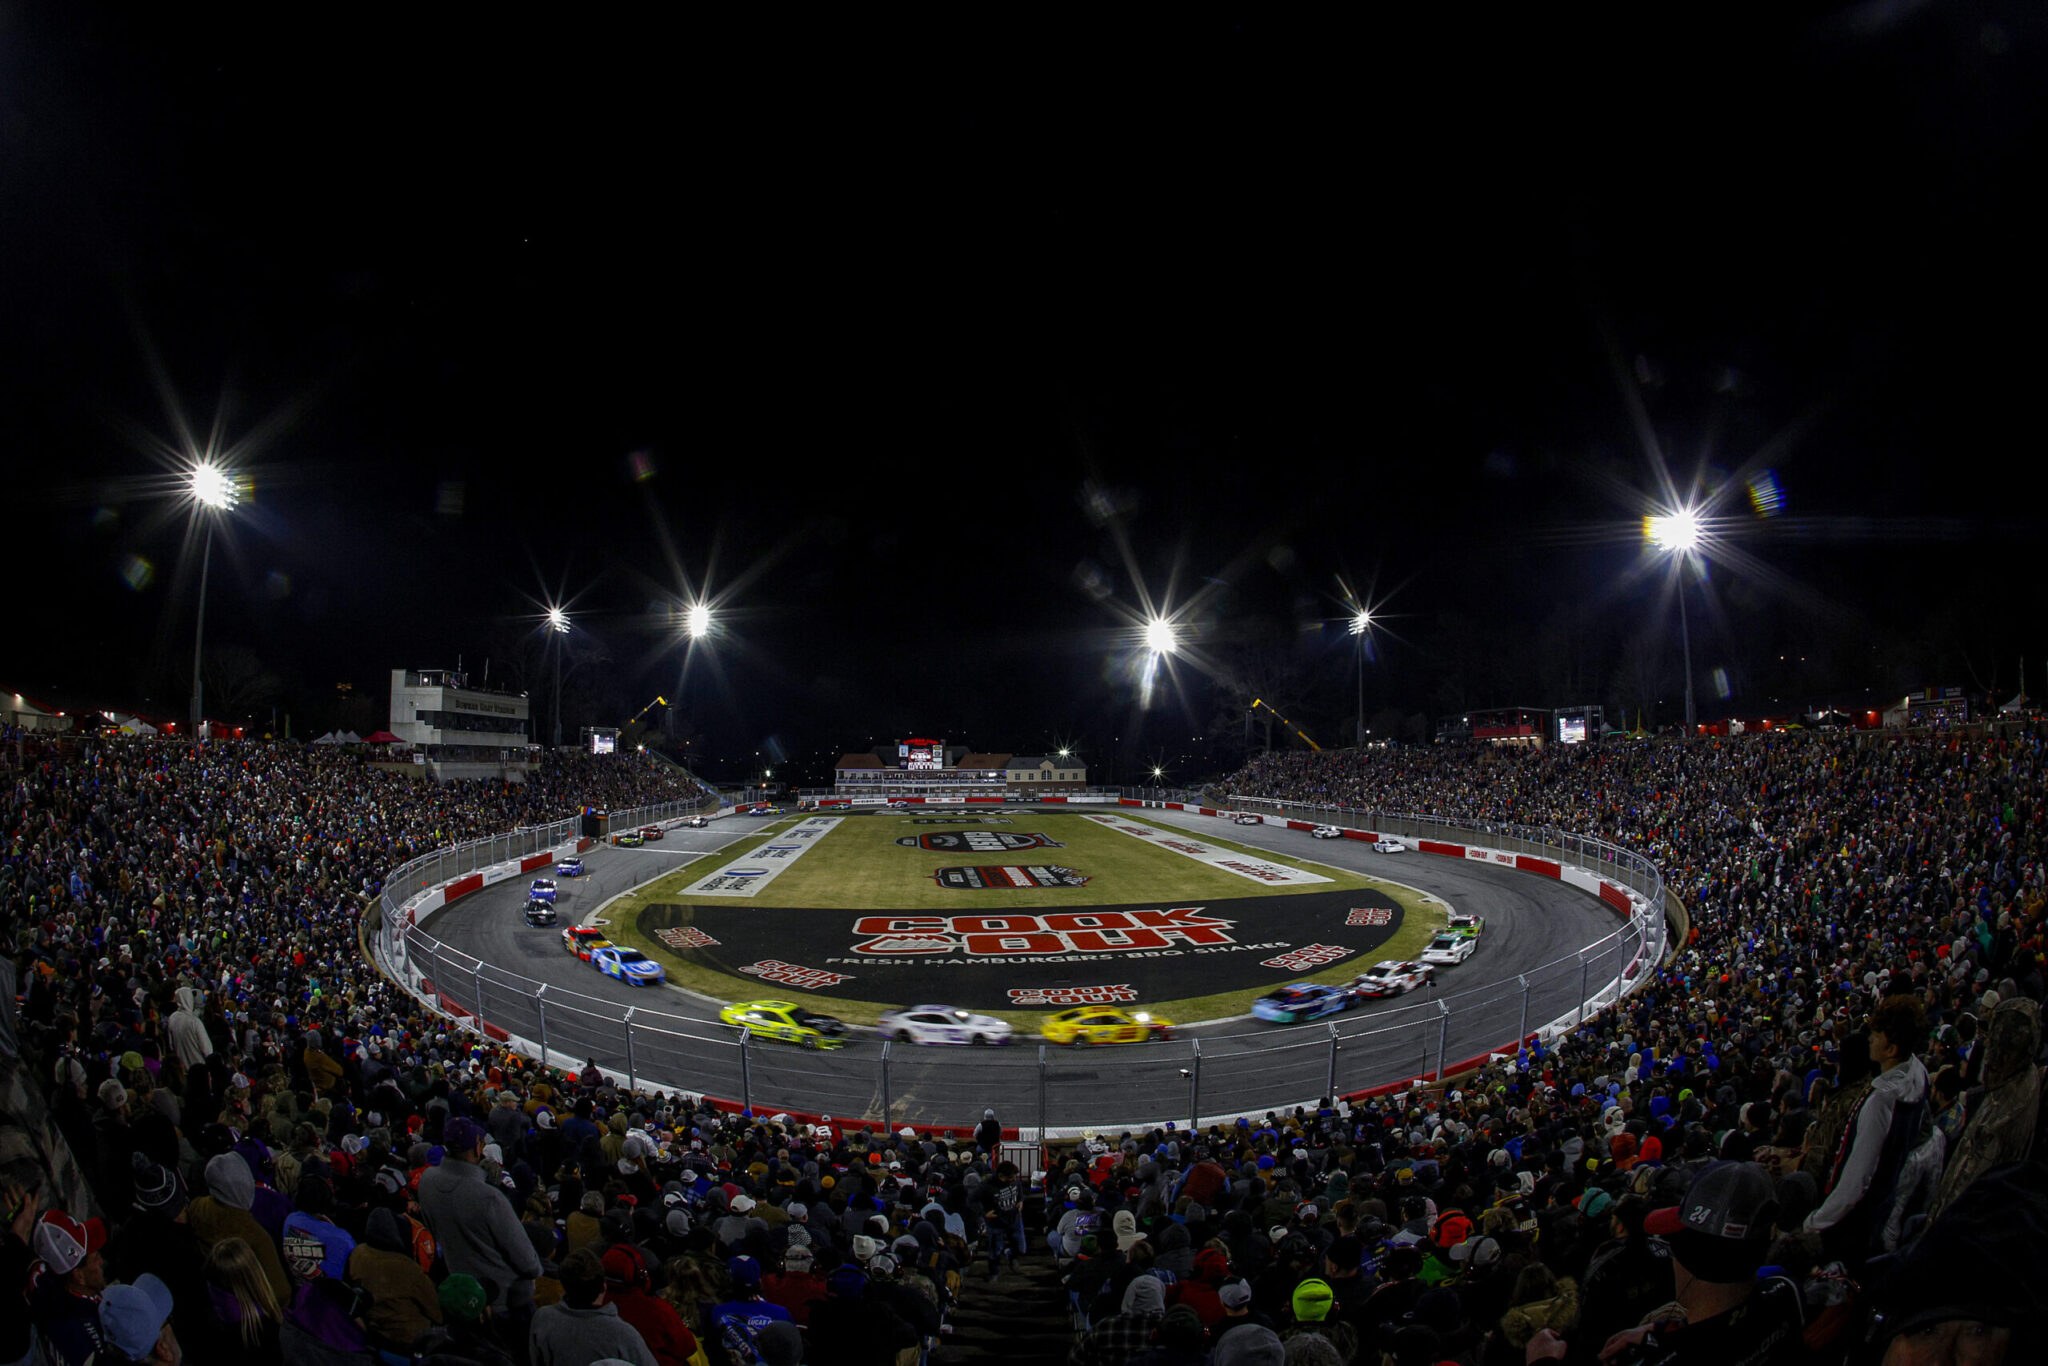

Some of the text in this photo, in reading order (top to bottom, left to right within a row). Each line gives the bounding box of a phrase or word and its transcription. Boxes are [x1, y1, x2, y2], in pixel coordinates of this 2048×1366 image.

[852, 907, 1238, 936] COOK
[671, 926, 722, 947] COOK
[961, 922, 1237, 956] OUT
[824, 941, 1292, 965] FRESH HAMBURGERS BBQ SHAKES
[1260, 943, 1331, 968] COOK
[1302, 945, 1356, 965] OUT
[753, 959, 856, 985] COOK
[758, 968, 836, 990] OUT
[1007, 984, 1138, 998] COOK
[1048, 993, 1136, 1005] OUT
[1688, 1205, 1712, 1225] 24
